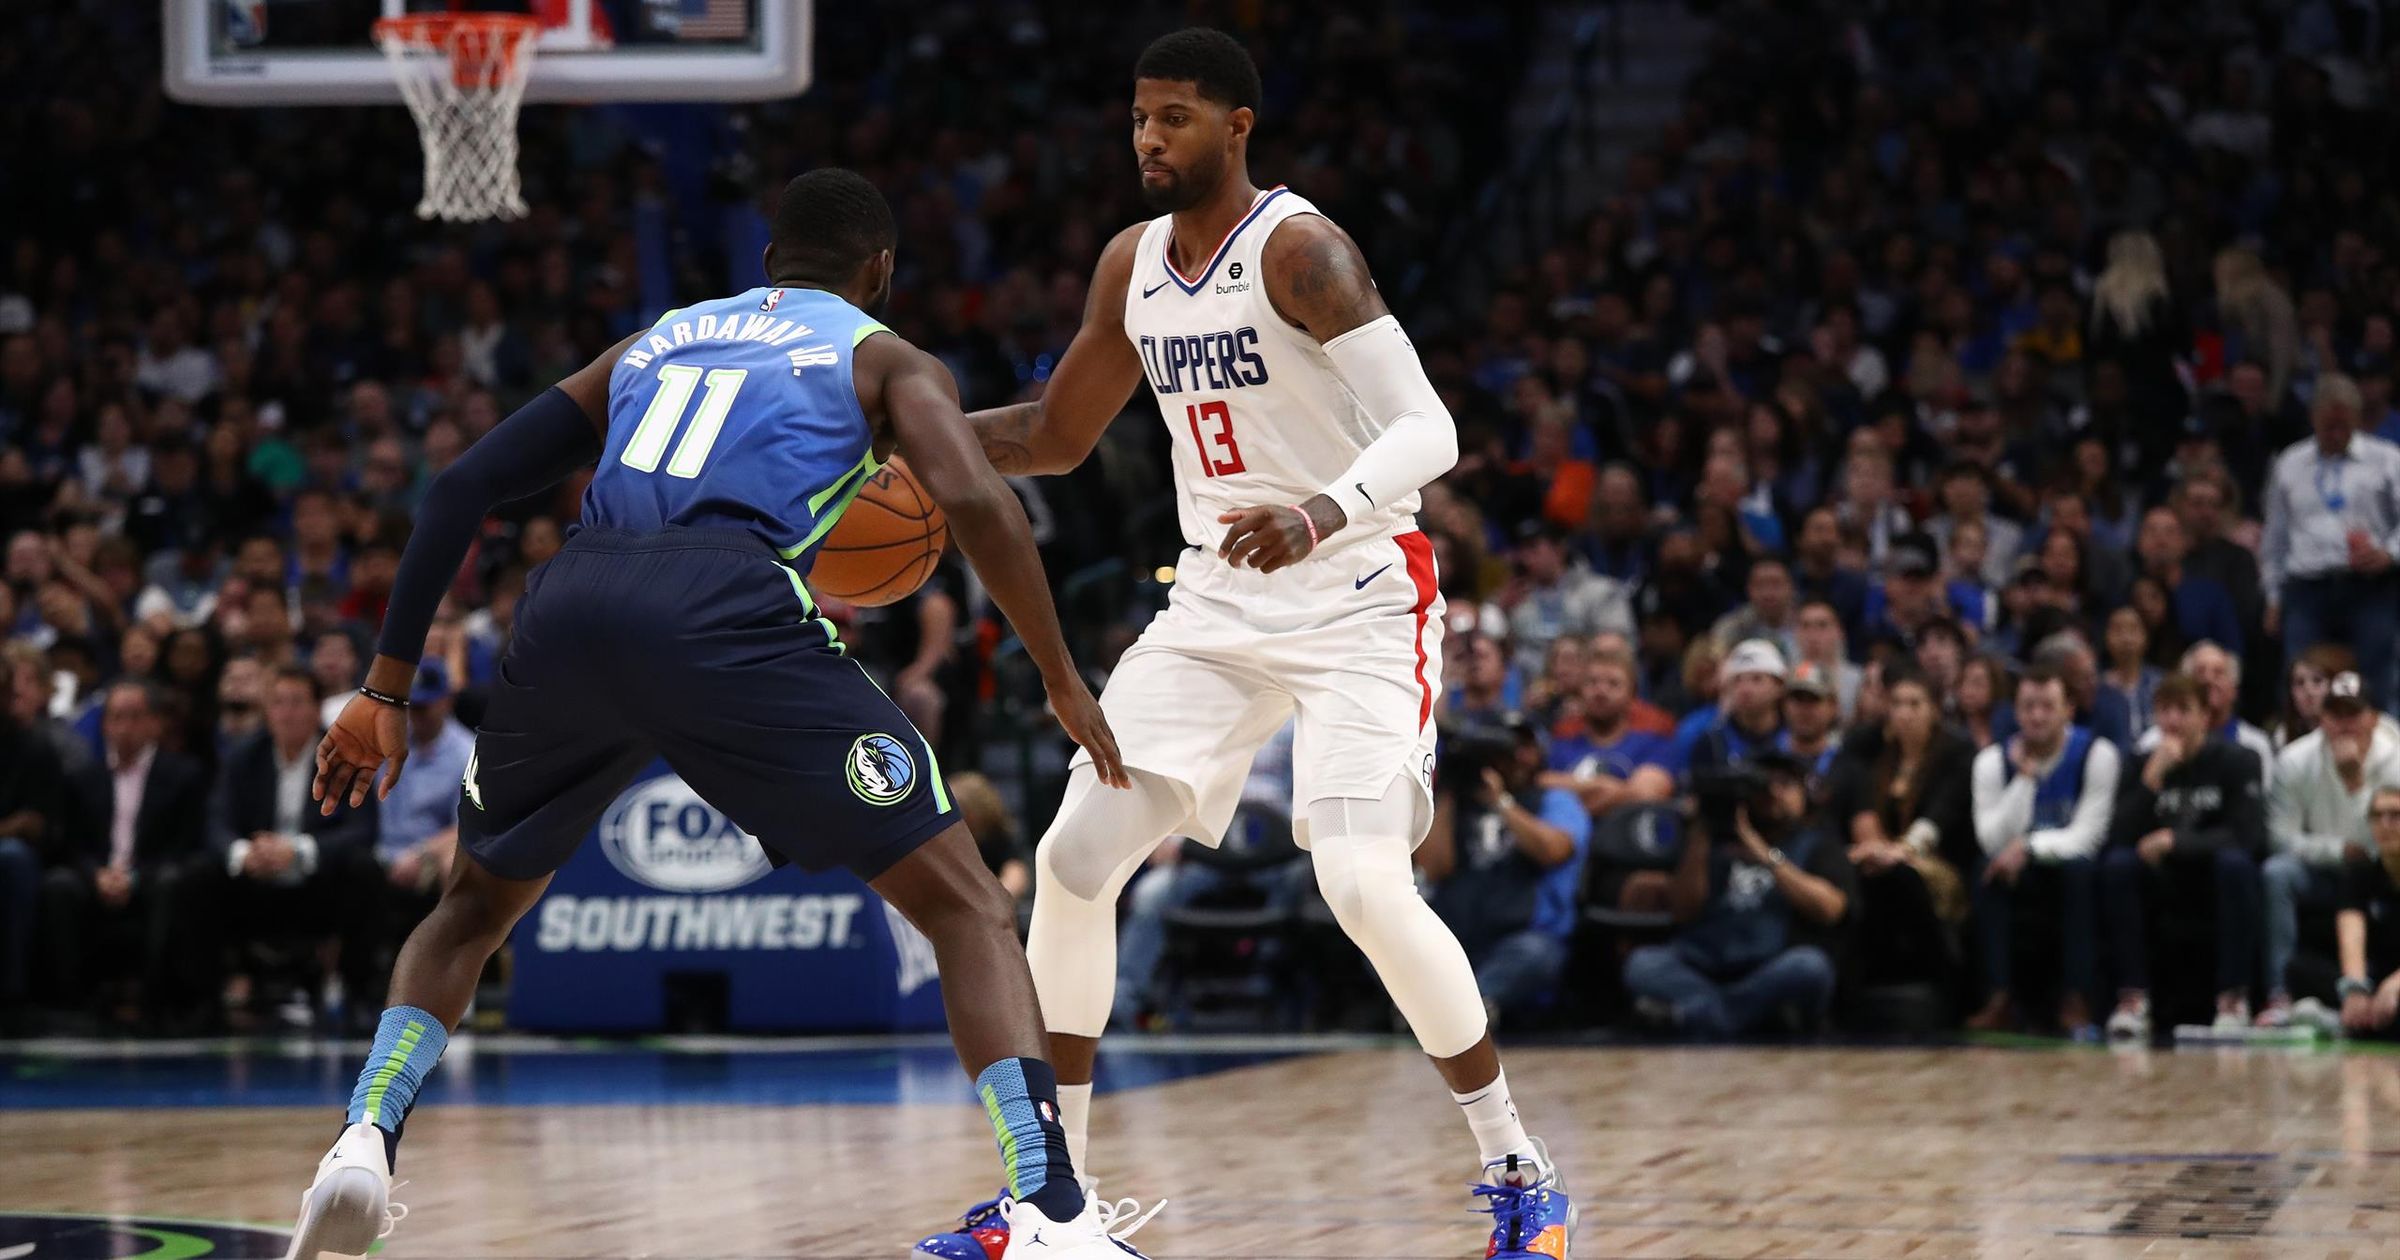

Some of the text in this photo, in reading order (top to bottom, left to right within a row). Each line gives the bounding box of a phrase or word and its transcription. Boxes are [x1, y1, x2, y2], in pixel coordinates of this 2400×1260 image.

[1215, 282, 1250, 295] bumble
[623, 313, 839, 376] HARDAWAY JR.
[1140, 326, 1269, 393] CLIPPERS
[620, 364, 748, 479] 11
[1186, 400, 1247, 477] 13
[537, 894, 863, 950] SOUTHWEST
